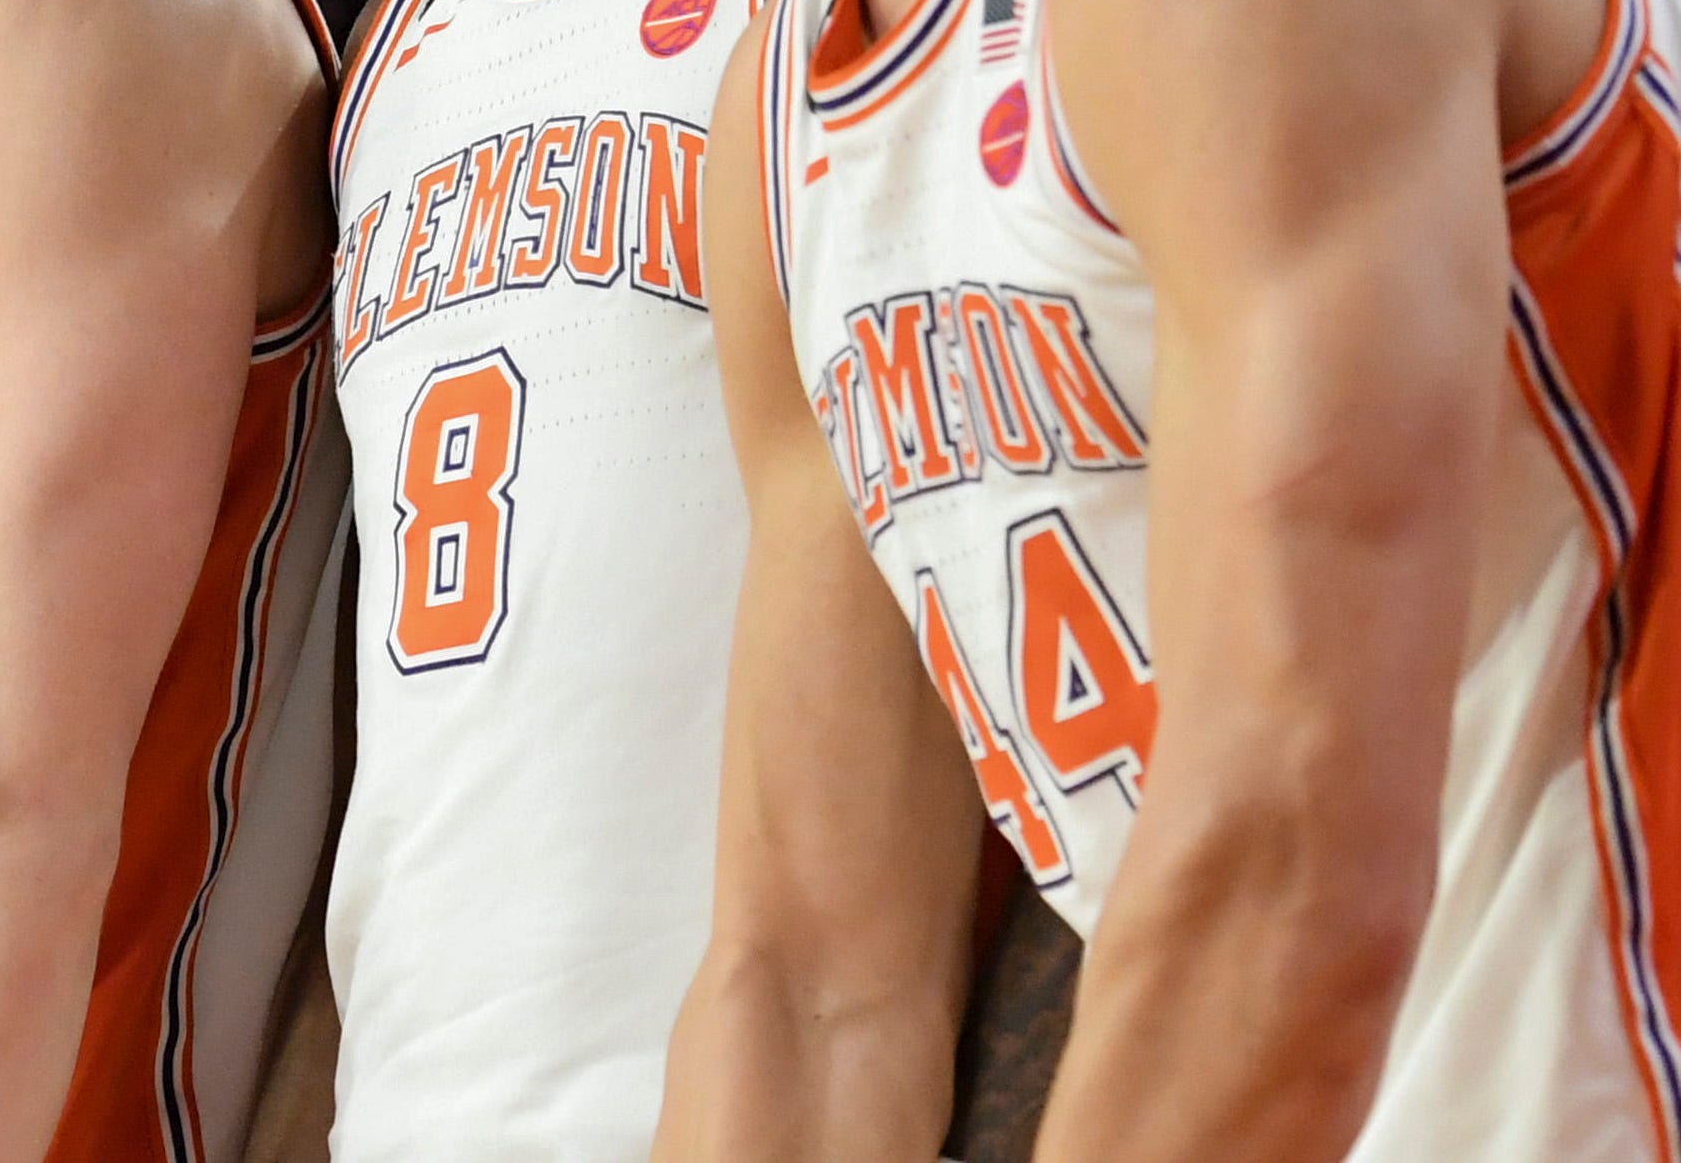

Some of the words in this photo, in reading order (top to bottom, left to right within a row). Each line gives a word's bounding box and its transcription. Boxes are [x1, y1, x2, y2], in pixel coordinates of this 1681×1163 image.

[334, 110, 710, 387] LEMSON
[386, 346, 526, 676] 8
[915, 507, 1159, 891] 44
